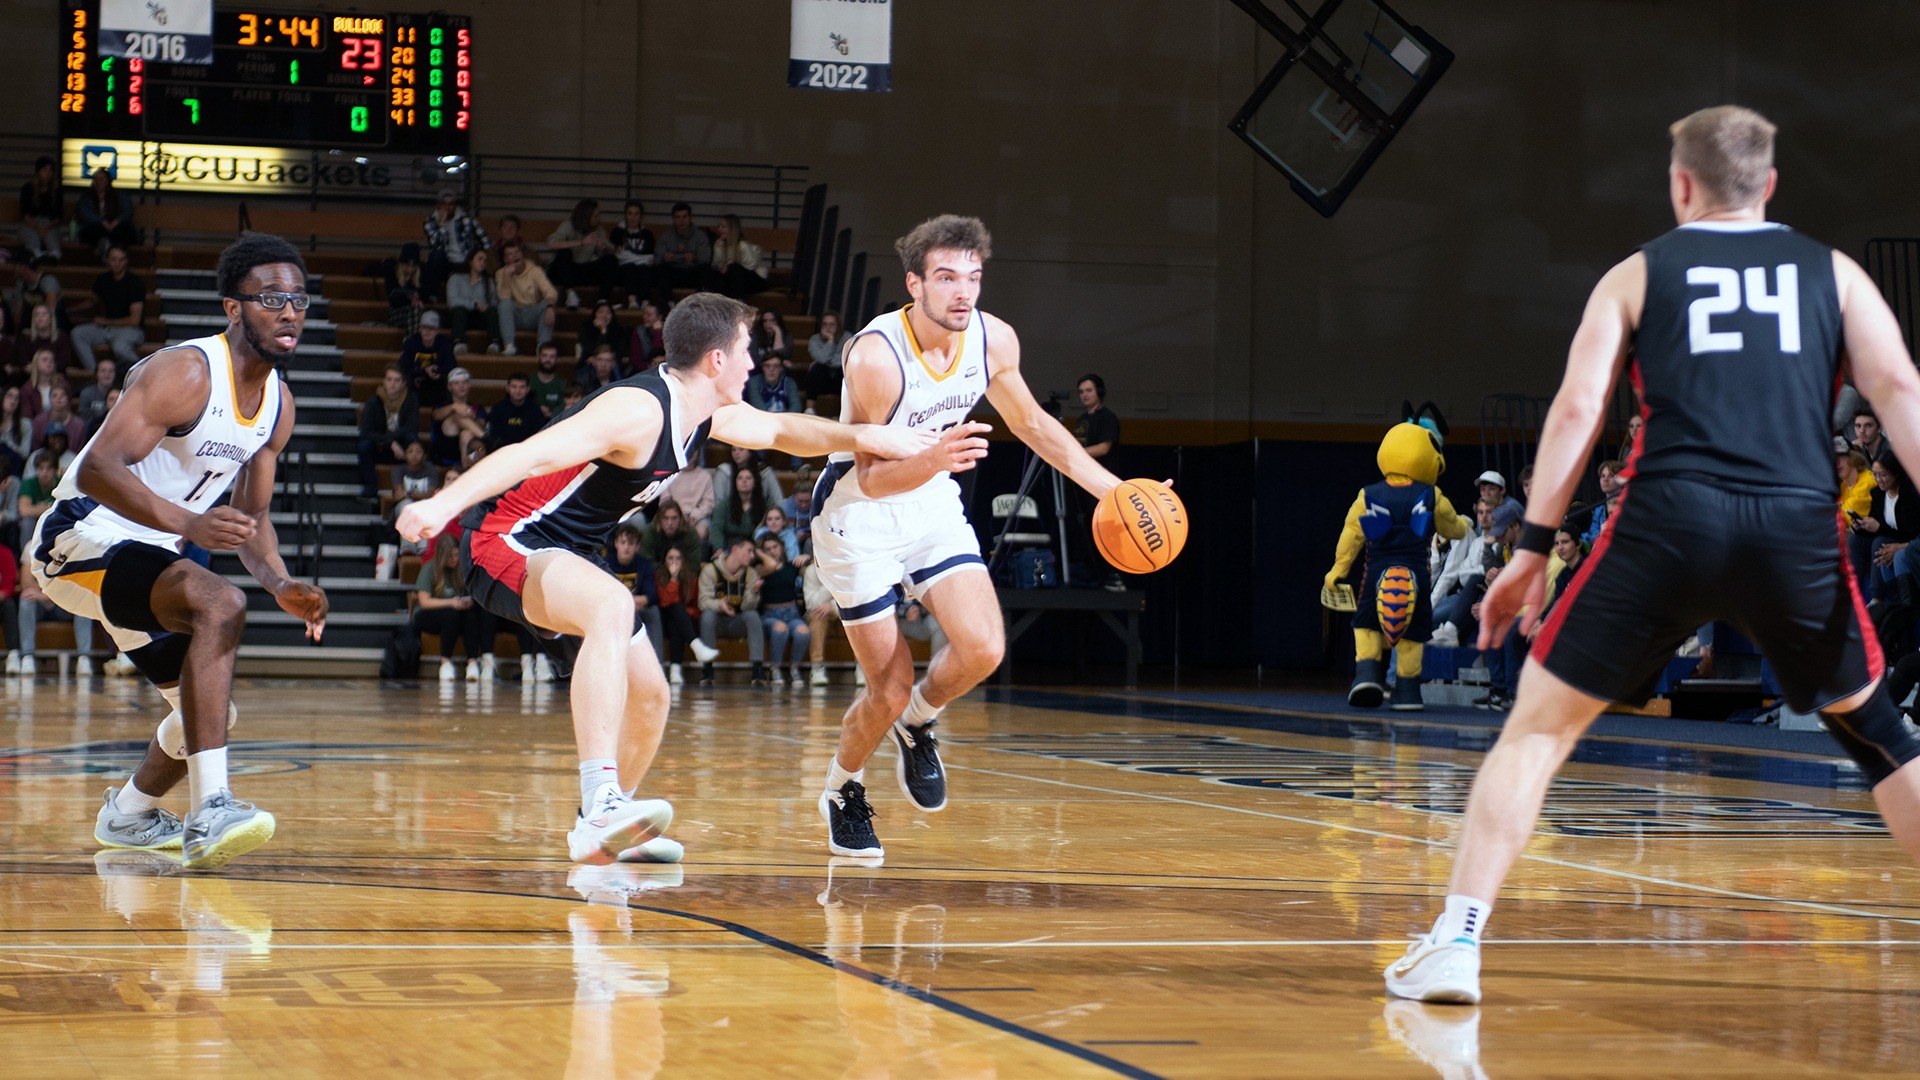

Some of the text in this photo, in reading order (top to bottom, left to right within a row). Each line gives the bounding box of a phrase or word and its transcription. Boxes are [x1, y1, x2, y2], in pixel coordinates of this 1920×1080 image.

[72, 8, 88, 29] 3
[237, 13, 321, 48] 3:44
[72, 30, 88, 50] 5
[125, 32, 186, 61] 2016
[396, 26, 471, 48] 11 0 5
[66, 51, 88, 71] 12
[341, 37, 383, 71] 23
[391, 46, 471, 68] 20 0 6
[66, 72, 144, 95] 13 1 2
[289, 58, 301, 85] 1
[391, 66, 471, 89] 24 0 0
[808, 63, 868, 89] 2022
[60, 92, 144, 116] 22 1 6
[391, 87, 471, 109] 33 0 7
[182, 97, 201, 126] 7
[350, 105, 370, 133] 0
[390, 108, 471, 131] 41 0 2
[143, 152, 391, 186] @CUJackets
[1686, 264, 1801, 355] 24
[196, 440, 252, 463] CEDARVILL
[1128, 492, 1164, 554] Wilson
